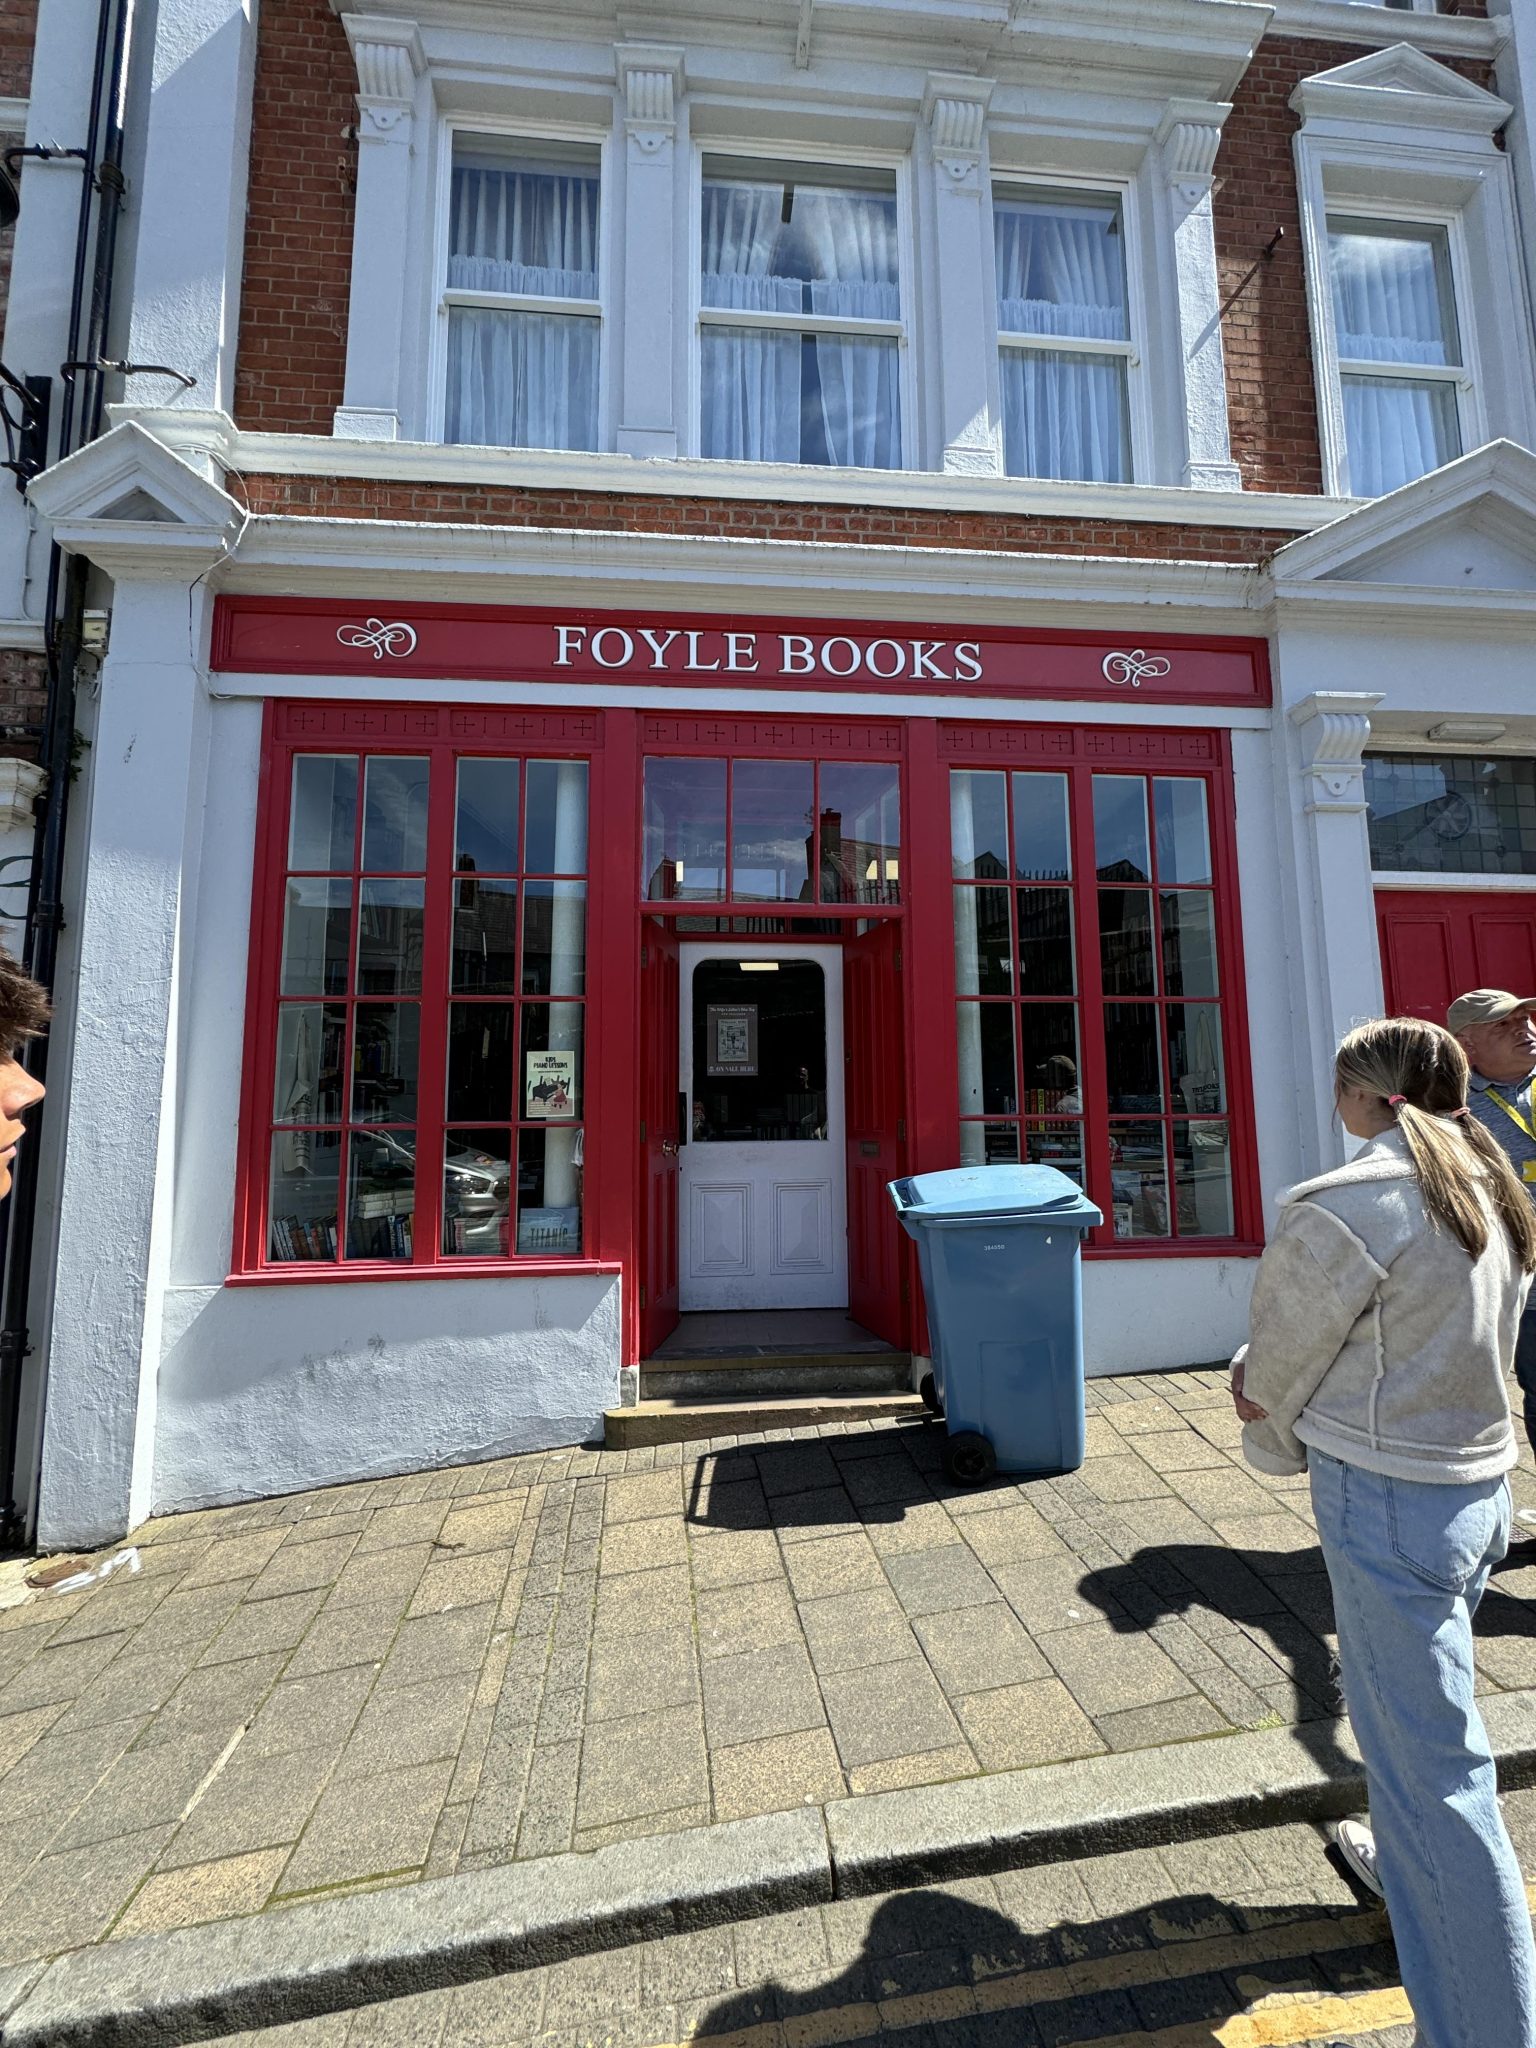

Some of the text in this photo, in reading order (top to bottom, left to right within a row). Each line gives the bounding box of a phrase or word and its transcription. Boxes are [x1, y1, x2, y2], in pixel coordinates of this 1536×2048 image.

[552, 625, 983, 682] FOYLE BOOKS
[530, 1228, 568, 1247] TITANIC
